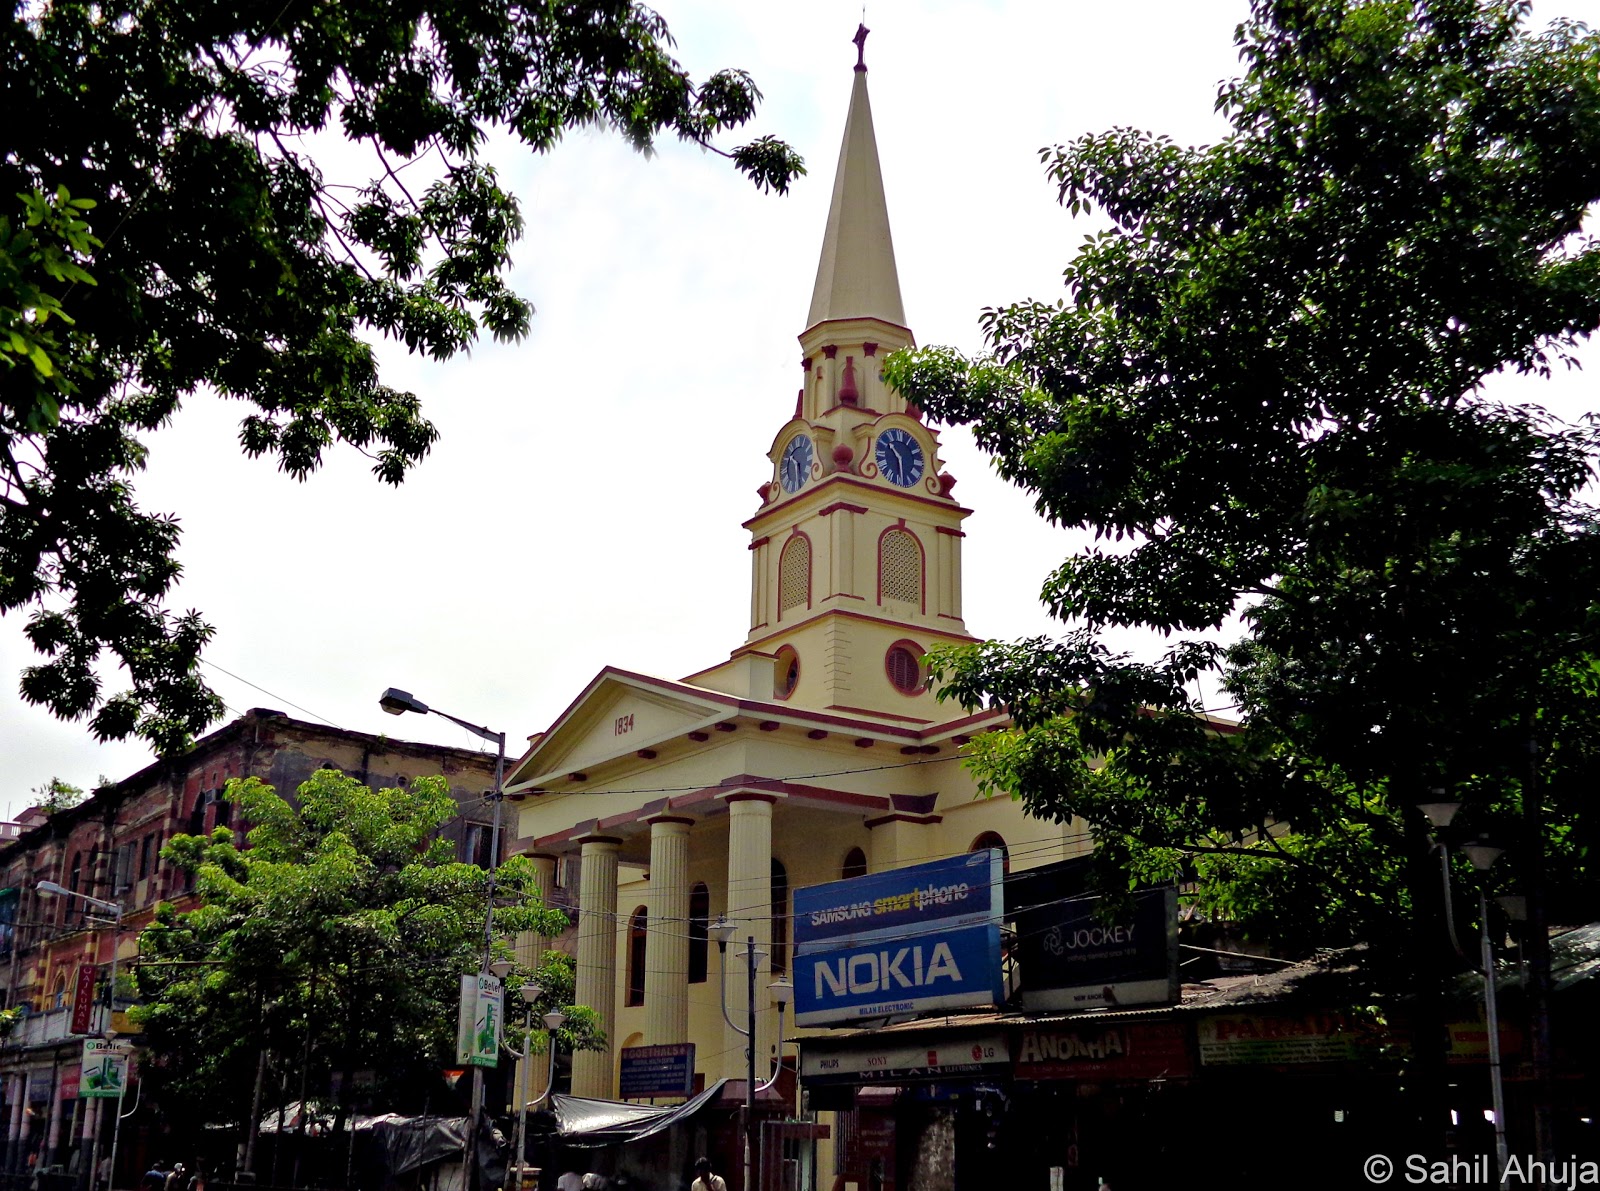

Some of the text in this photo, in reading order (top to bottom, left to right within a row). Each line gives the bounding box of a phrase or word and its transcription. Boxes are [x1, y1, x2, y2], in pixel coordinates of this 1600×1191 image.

[614, 713, 634, 737] 1834
[811, 901, 872, 926] SAMSUNG
[1066, 923, 1136, 950] JOCKEY
[814, 941, 963, 1000] NOKIA
[859, 1006, 877, 1015] MILAN
[629, 1046, 679, 1059] GOETHALS
[983, 1048, 995, 1058] LG
[820, 1058, 839, 1069] PHILIPS
[867, 1056, 888, 1066] SONY
[859, 1065, 942, 1080] MILAN
